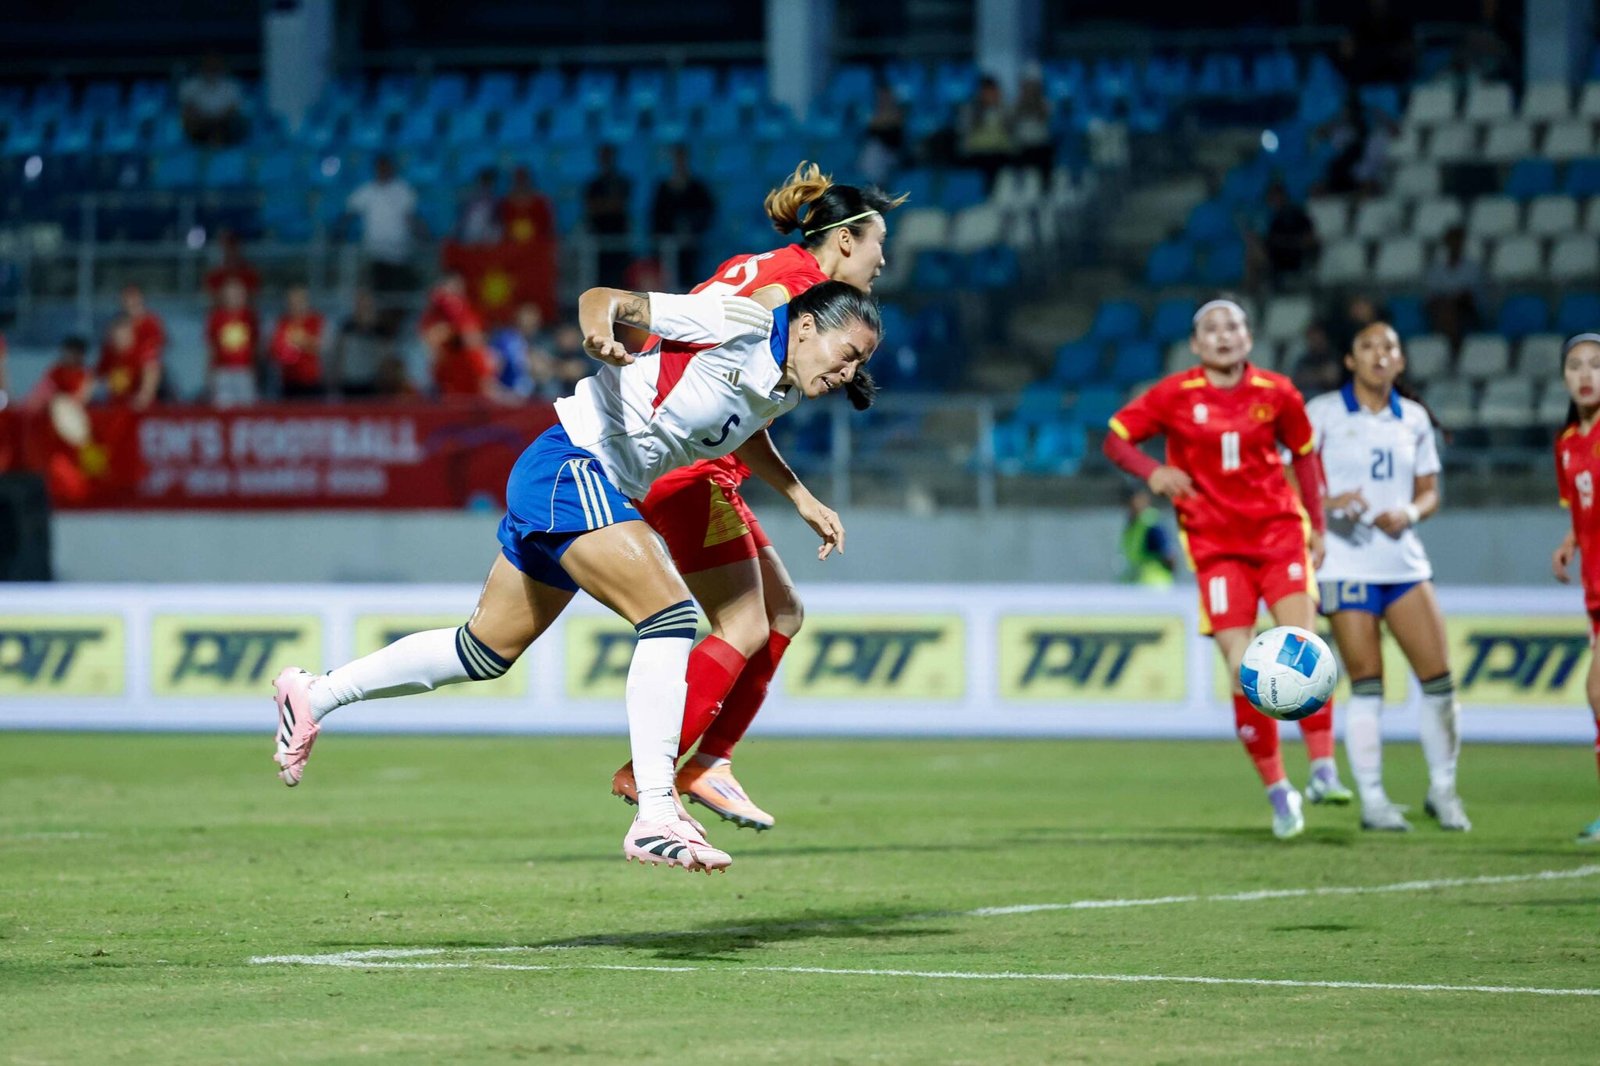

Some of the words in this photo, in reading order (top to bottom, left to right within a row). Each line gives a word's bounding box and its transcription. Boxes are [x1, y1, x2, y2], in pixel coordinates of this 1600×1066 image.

[231, 418, 421, 463] FOOTBALL
[701, 414, 740, 447] 5
[1221, 431, 1240, 471] 11
[1371, 450, 1393, 479] 21
[1209, 576, 1228, 614] 11
[170, 629, 303, 684] PTT
[804, 630, 944, 686] PTT
[1020, 631, 1165, 686] PTT
[1462, 634, 1590, 689] PTT
[1270, 677, 1279, 705] molten
